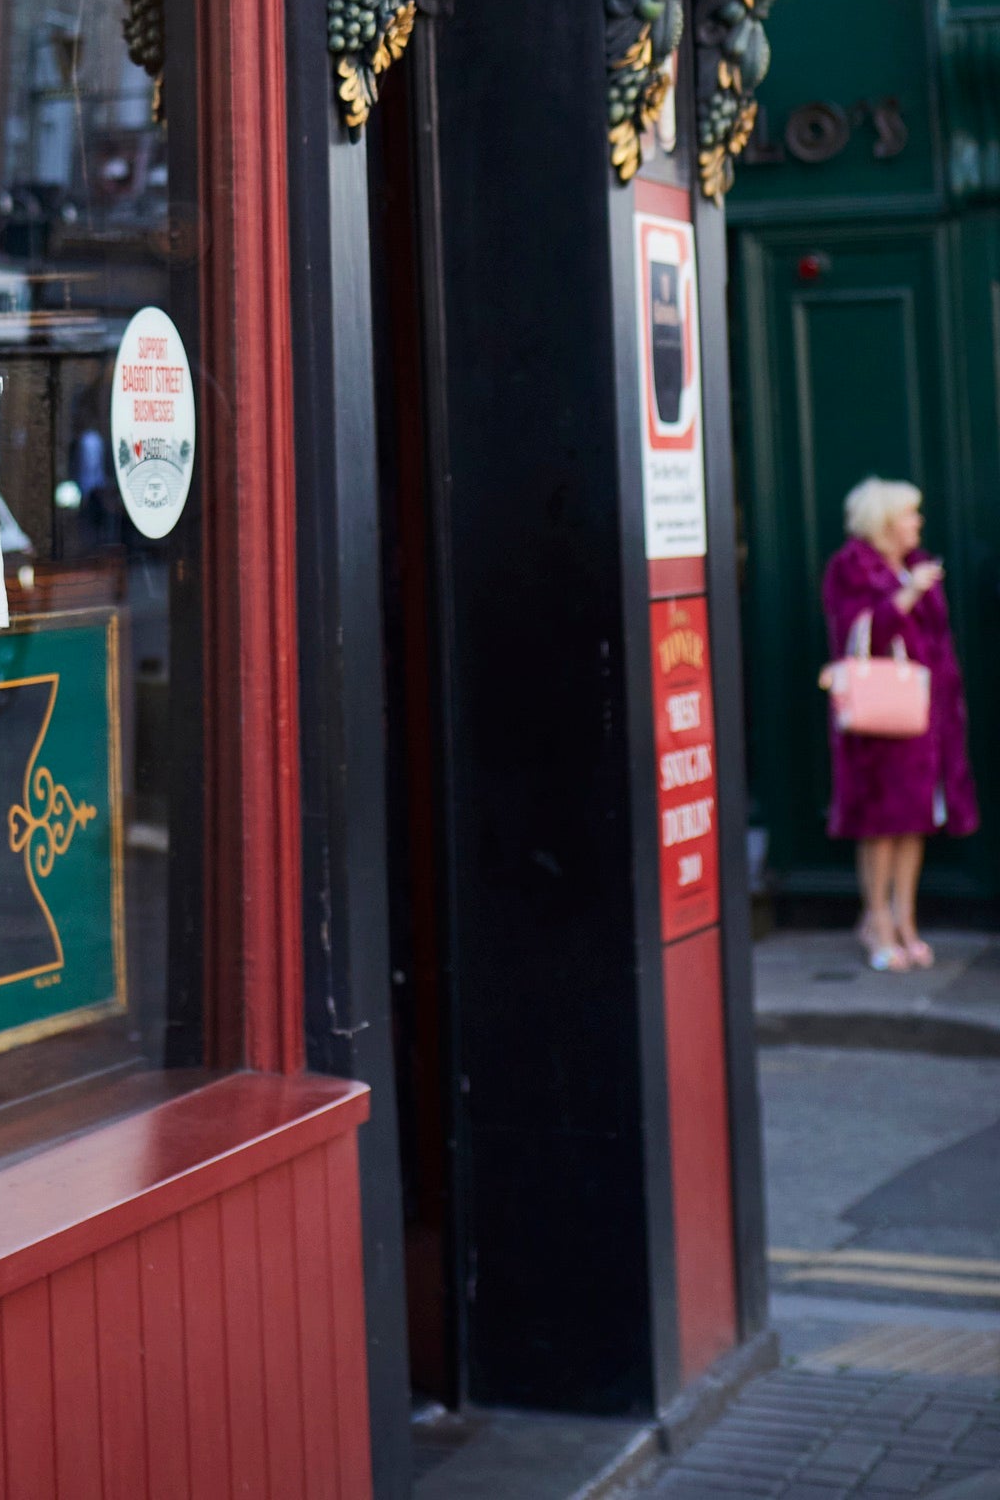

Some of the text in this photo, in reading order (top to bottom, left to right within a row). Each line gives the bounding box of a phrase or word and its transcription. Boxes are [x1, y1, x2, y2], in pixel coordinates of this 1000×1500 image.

[138, 336, 168, 360] SUPPORT
[122, 364, 184, 395] BAGGOT STREET
[133, 399, 175, 423] BUSINESSES
